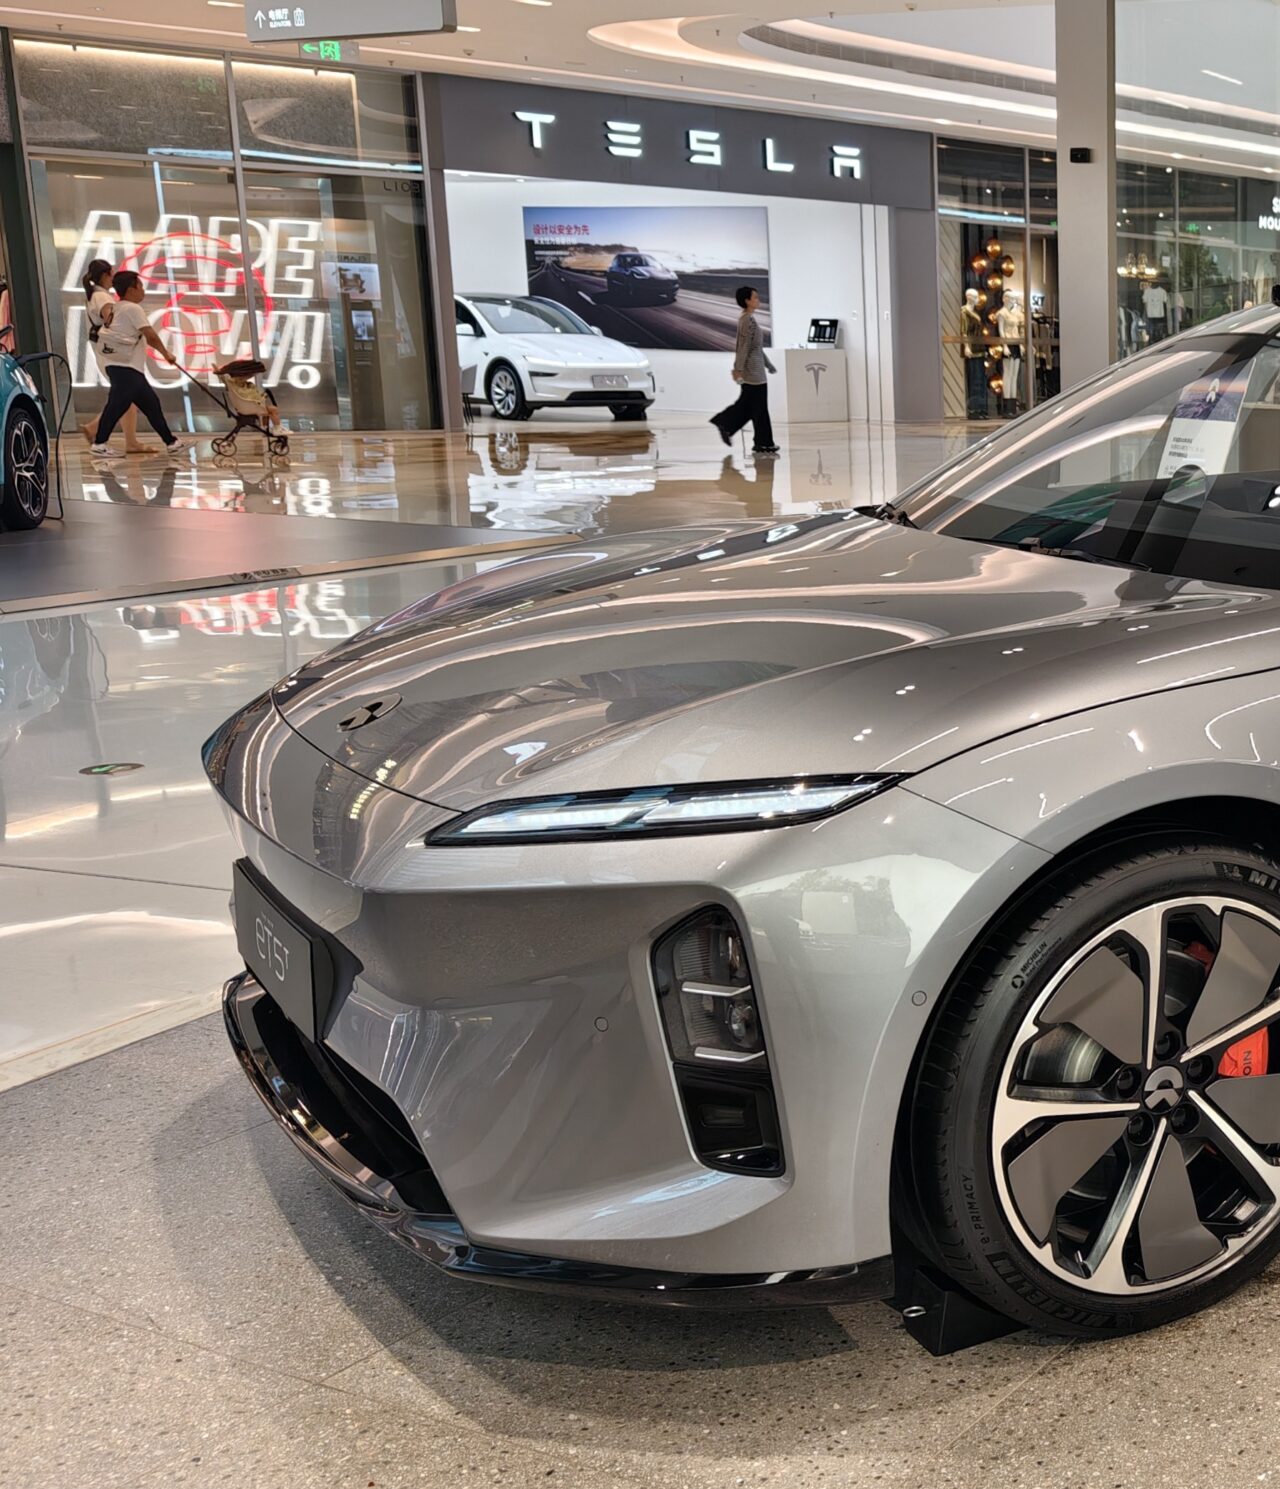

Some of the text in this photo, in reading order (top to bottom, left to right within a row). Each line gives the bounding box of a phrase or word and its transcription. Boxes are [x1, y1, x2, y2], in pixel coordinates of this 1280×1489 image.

[513, 111, 861, 180] TESLA
[533, 224, 590, 236] 设计以安全为先
[61, 210, 322, 298] AAPE
[1020, 941, 1047, 973] MICHELIN
[1243, 1050, 1252, 1076] NIO
